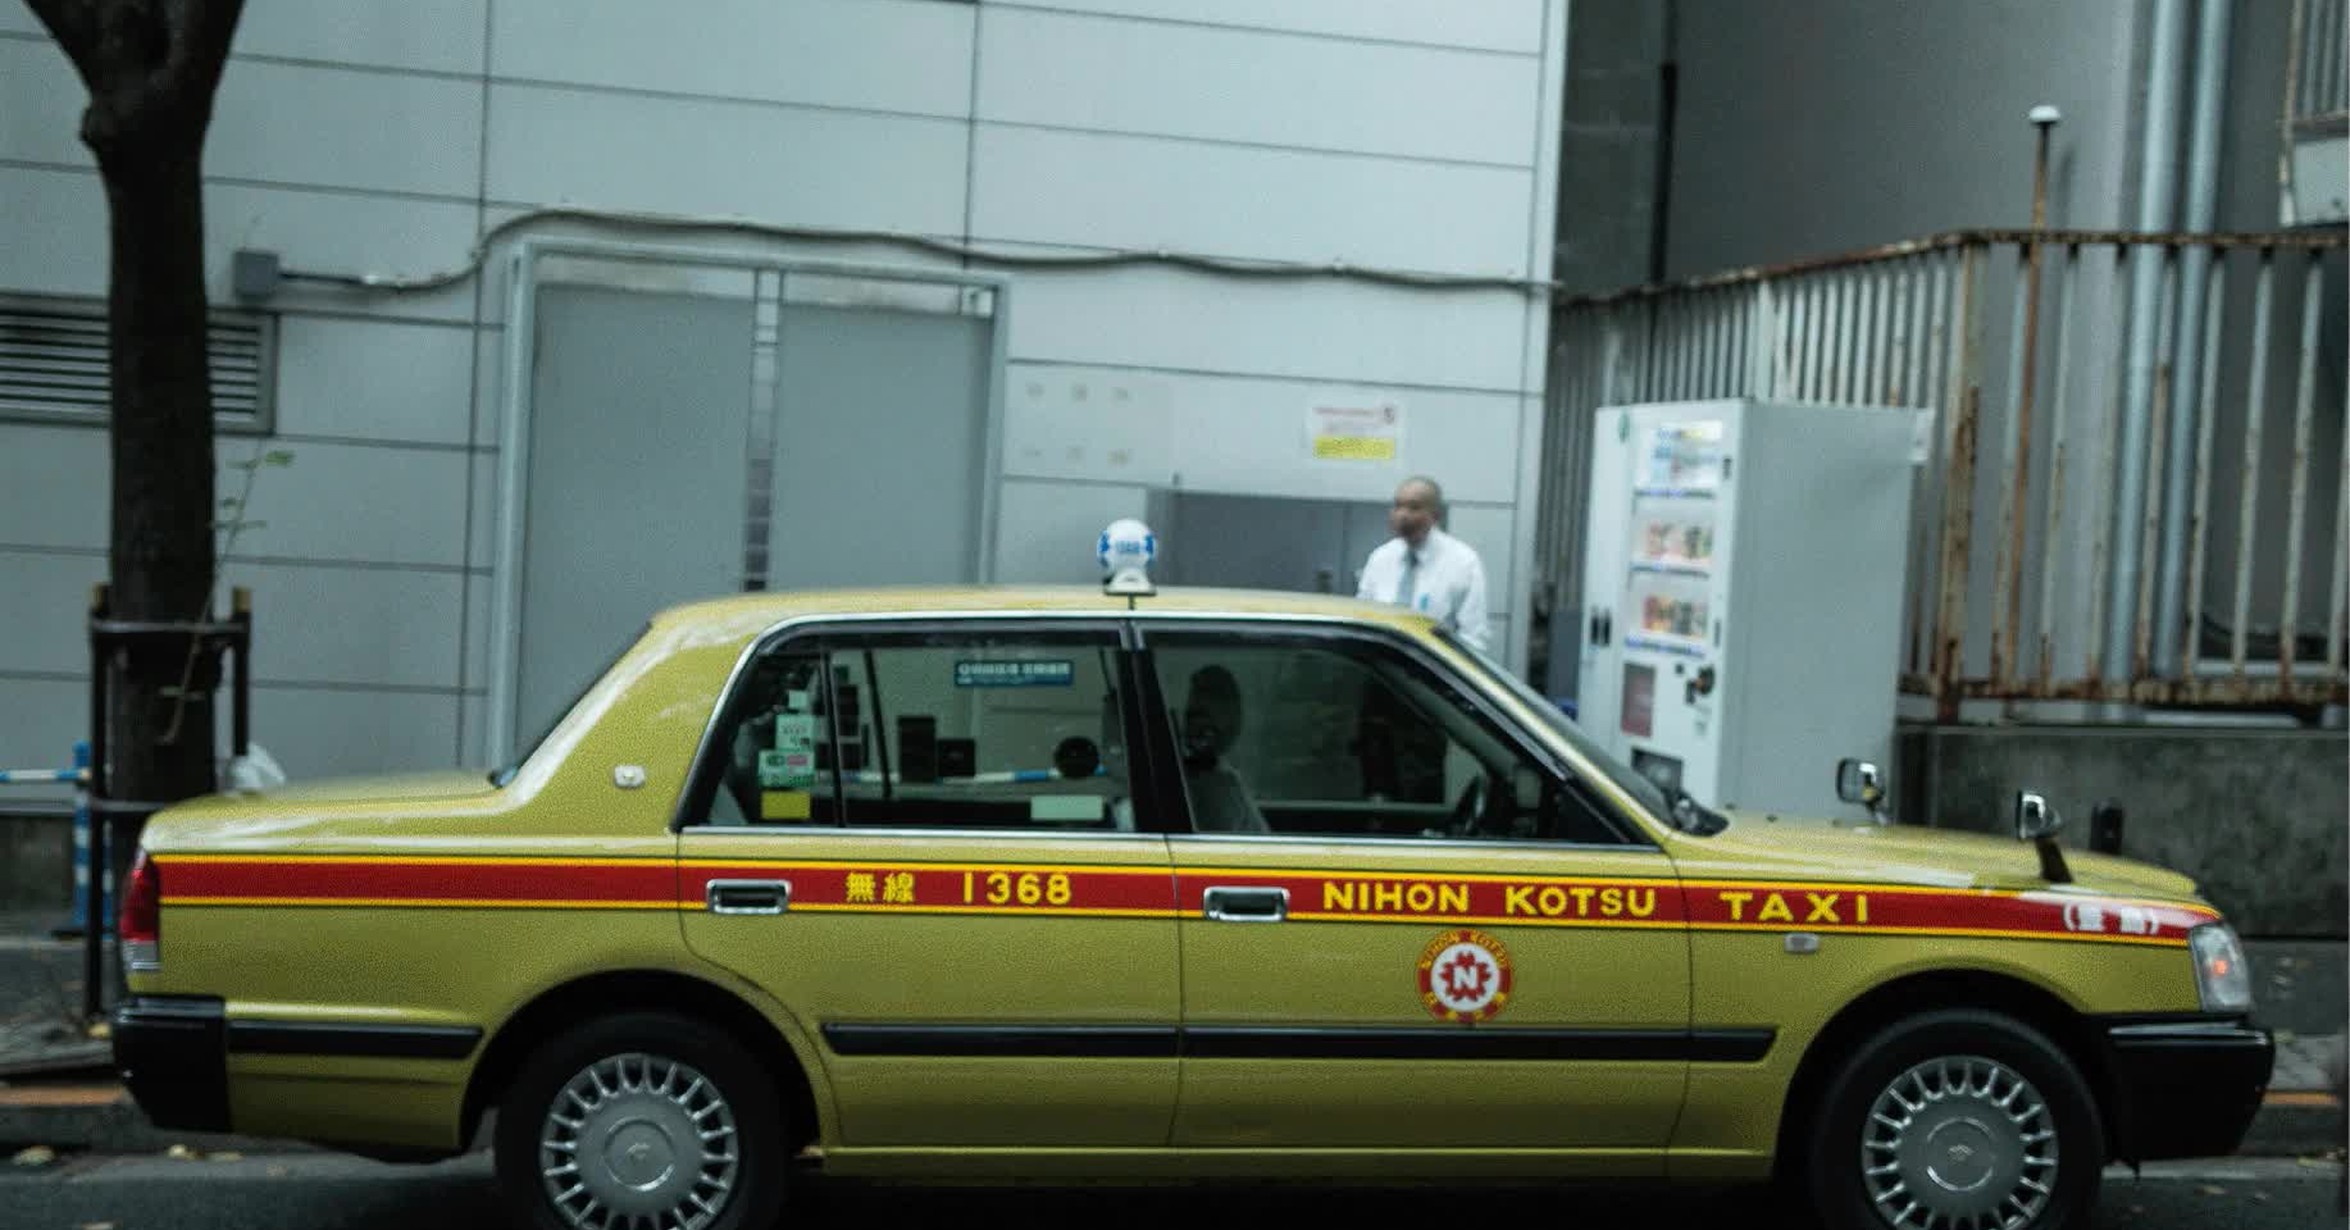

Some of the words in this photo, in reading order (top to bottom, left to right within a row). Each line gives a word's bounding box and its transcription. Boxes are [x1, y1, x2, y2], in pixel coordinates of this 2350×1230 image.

[845, 871, 915, 904] 無線
[963, 871, 1072, 906] 1368
[1322, 880, 1470, 913] NIHON
[1504, 885, 1656, 918] KOTSU
[1718, 890, 1869, 924] TAXI
[1453, 965, 1477, 990] N
